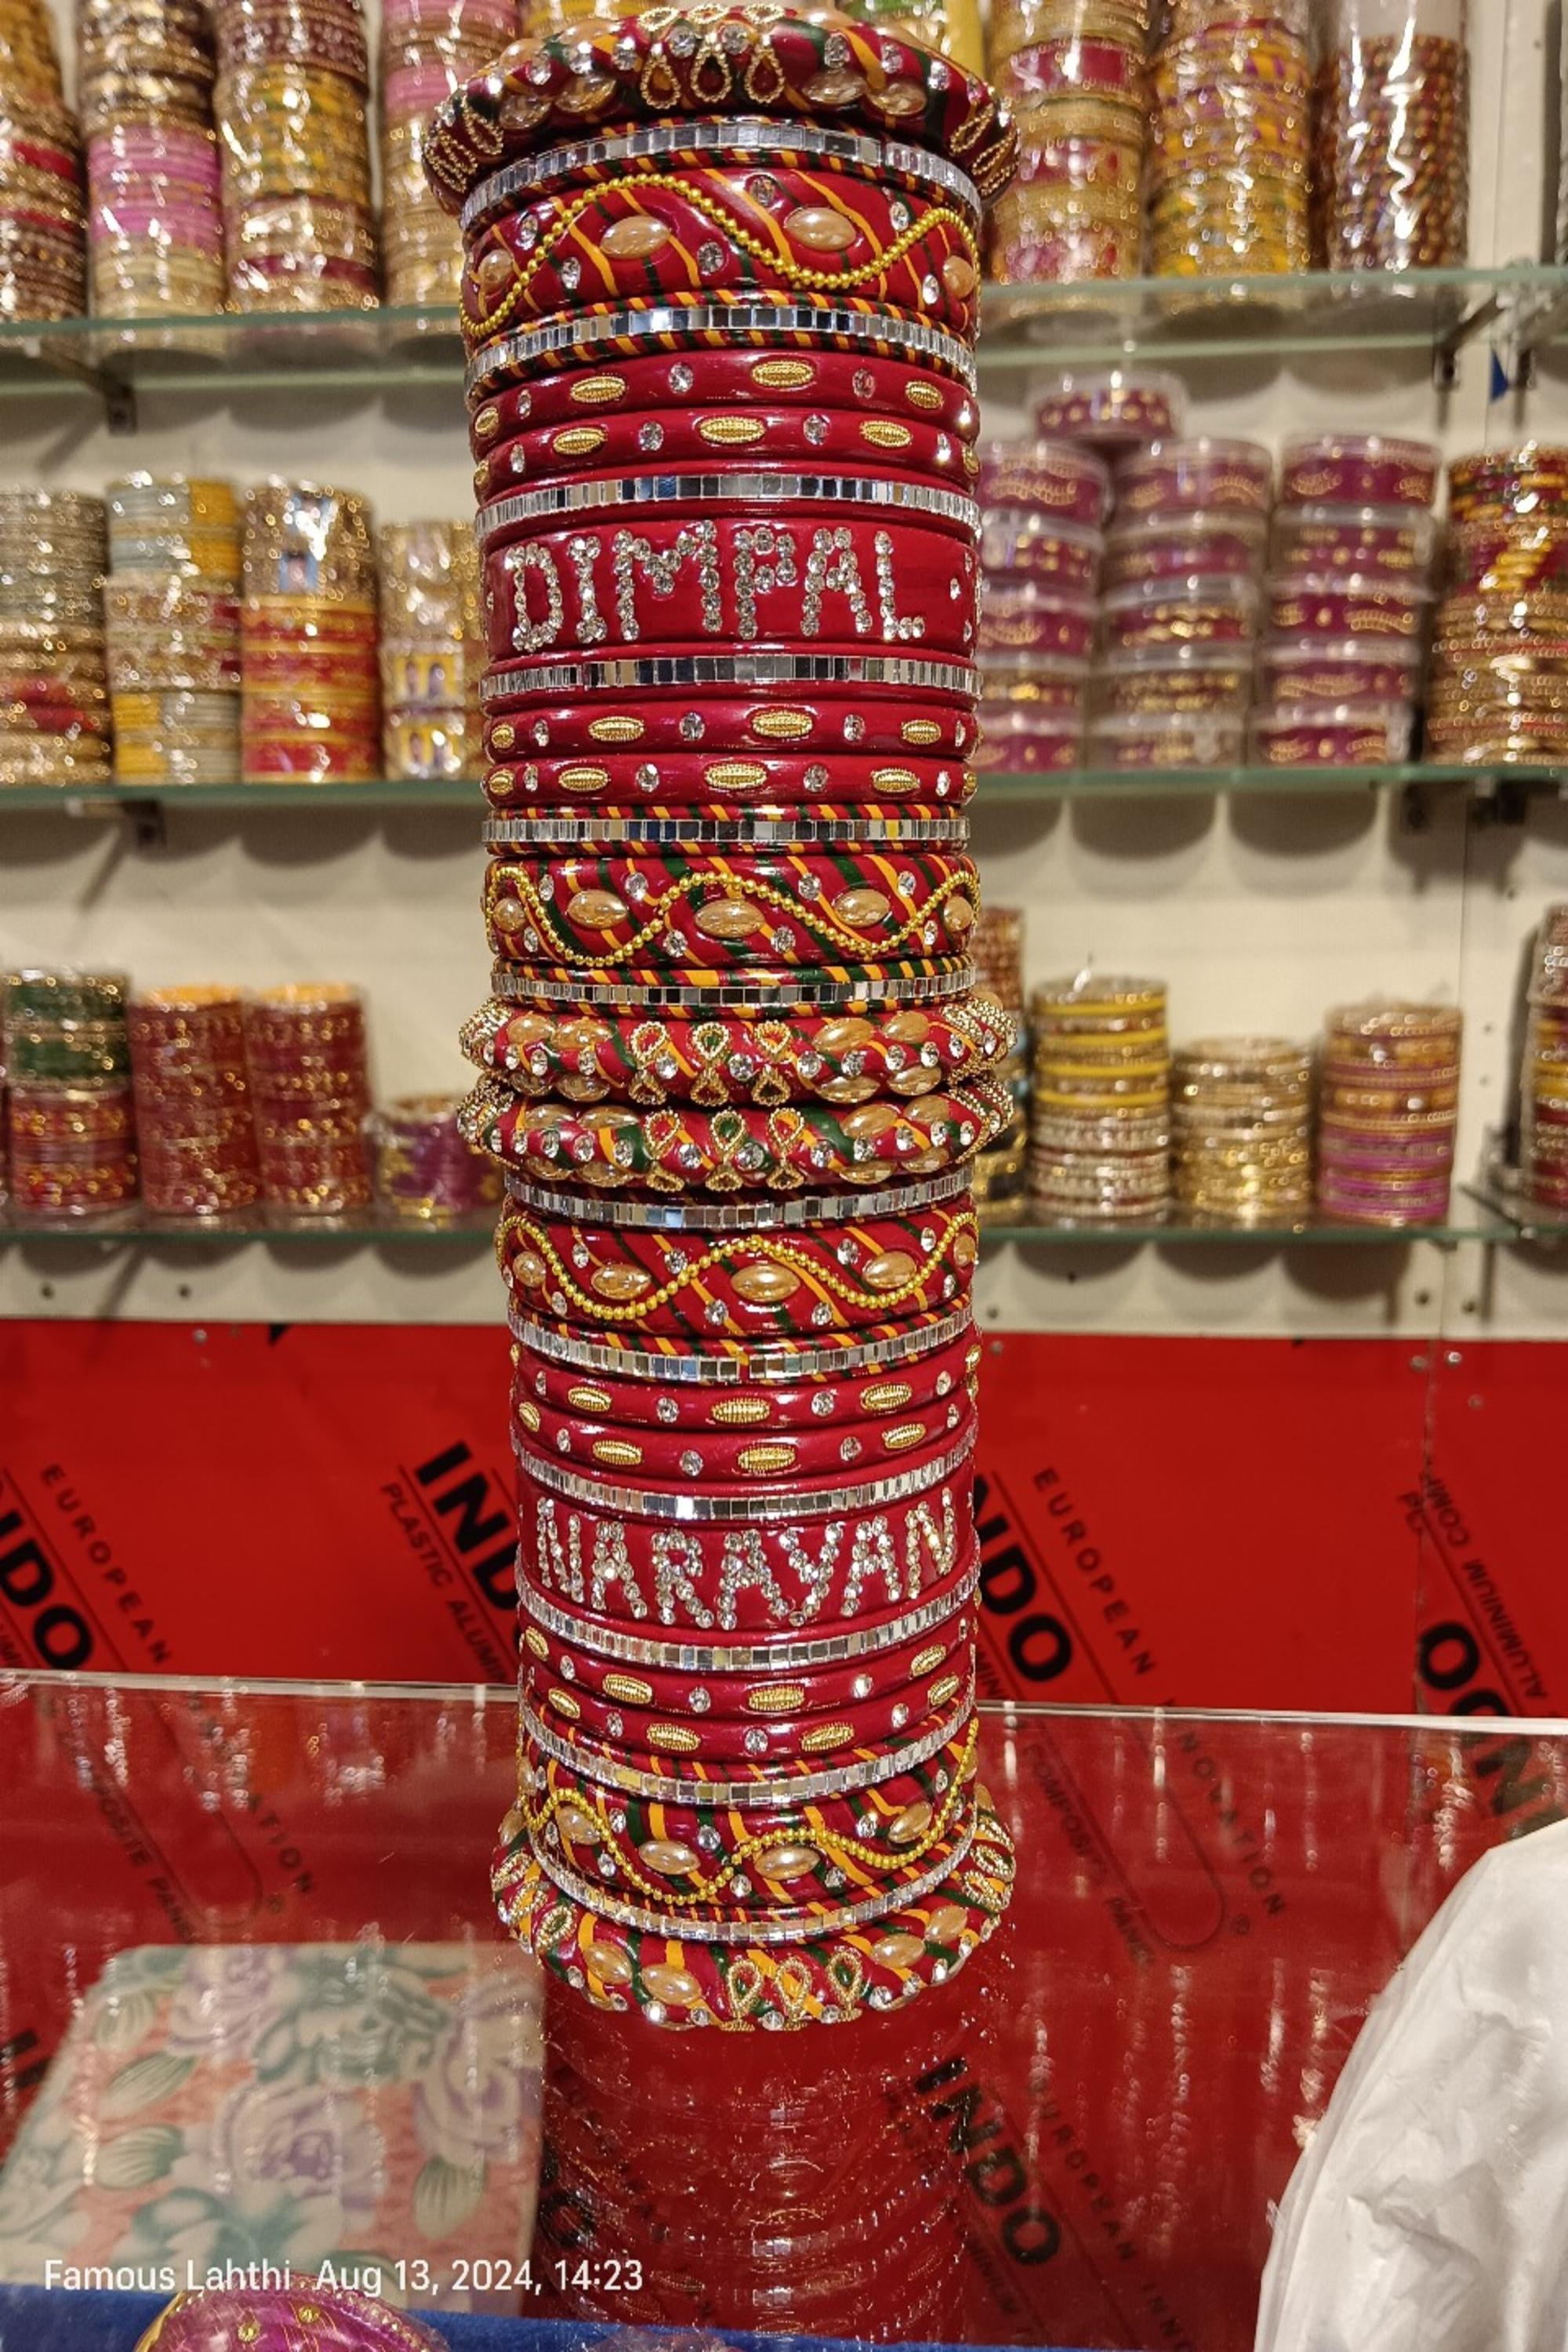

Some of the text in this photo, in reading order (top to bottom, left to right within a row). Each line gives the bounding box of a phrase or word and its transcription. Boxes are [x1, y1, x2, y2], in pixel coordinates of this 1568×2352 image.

[504, 518, 924, 652] DIMPAL
[42, 1464, 172, 1664] EUROPEAN
[380, 1483, 454, 1588] PLASTIC
[415, 1441, 520, 1654] IND
[537, 1486, 956, 1631] NARAYAN
[1034, 1468, 1156, 1675] EUROPEAN
[1463, 1559, 1548, 1699] ALUMINIUM
